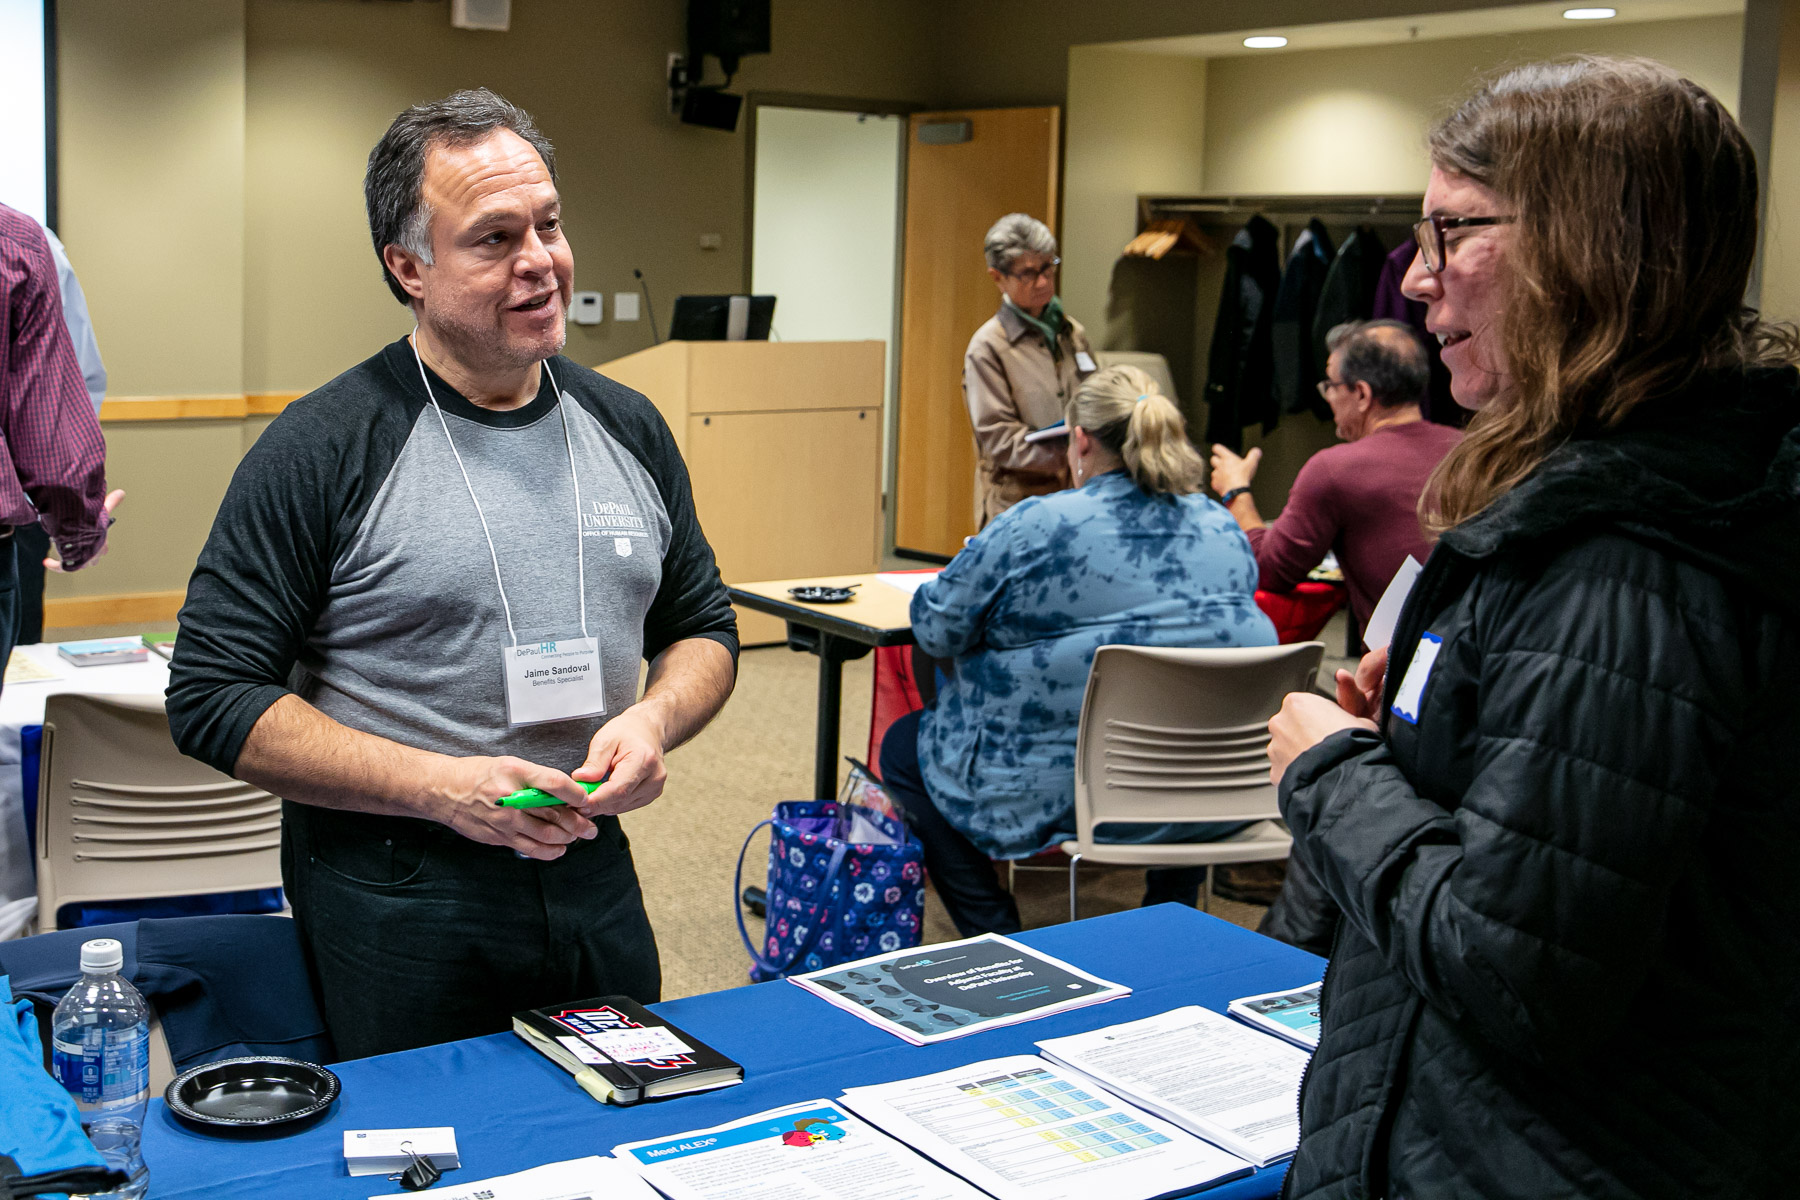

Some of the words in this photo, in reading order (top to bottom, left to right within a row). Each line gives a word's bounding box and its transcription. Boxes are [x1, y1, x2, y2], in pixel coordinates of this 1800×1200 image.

[582, 513, 644, 528] UNIVERSITY
[524, 668, 550, 679] Jaime
[552, 662, 590, 675] Sandoval
[532, 678, 556, 687] Benefits
[557, 675, 584, 684] Specialist
[923, 971, 967, 984] Overview
[975, 960, 1009, 973] Benefits
[981, 967, 1013, 980] Faculty
[958, 979, 991, 991] DePaul
[989, 970, 1035, 985] University
[646, 1147, 680, 1158] Meet
